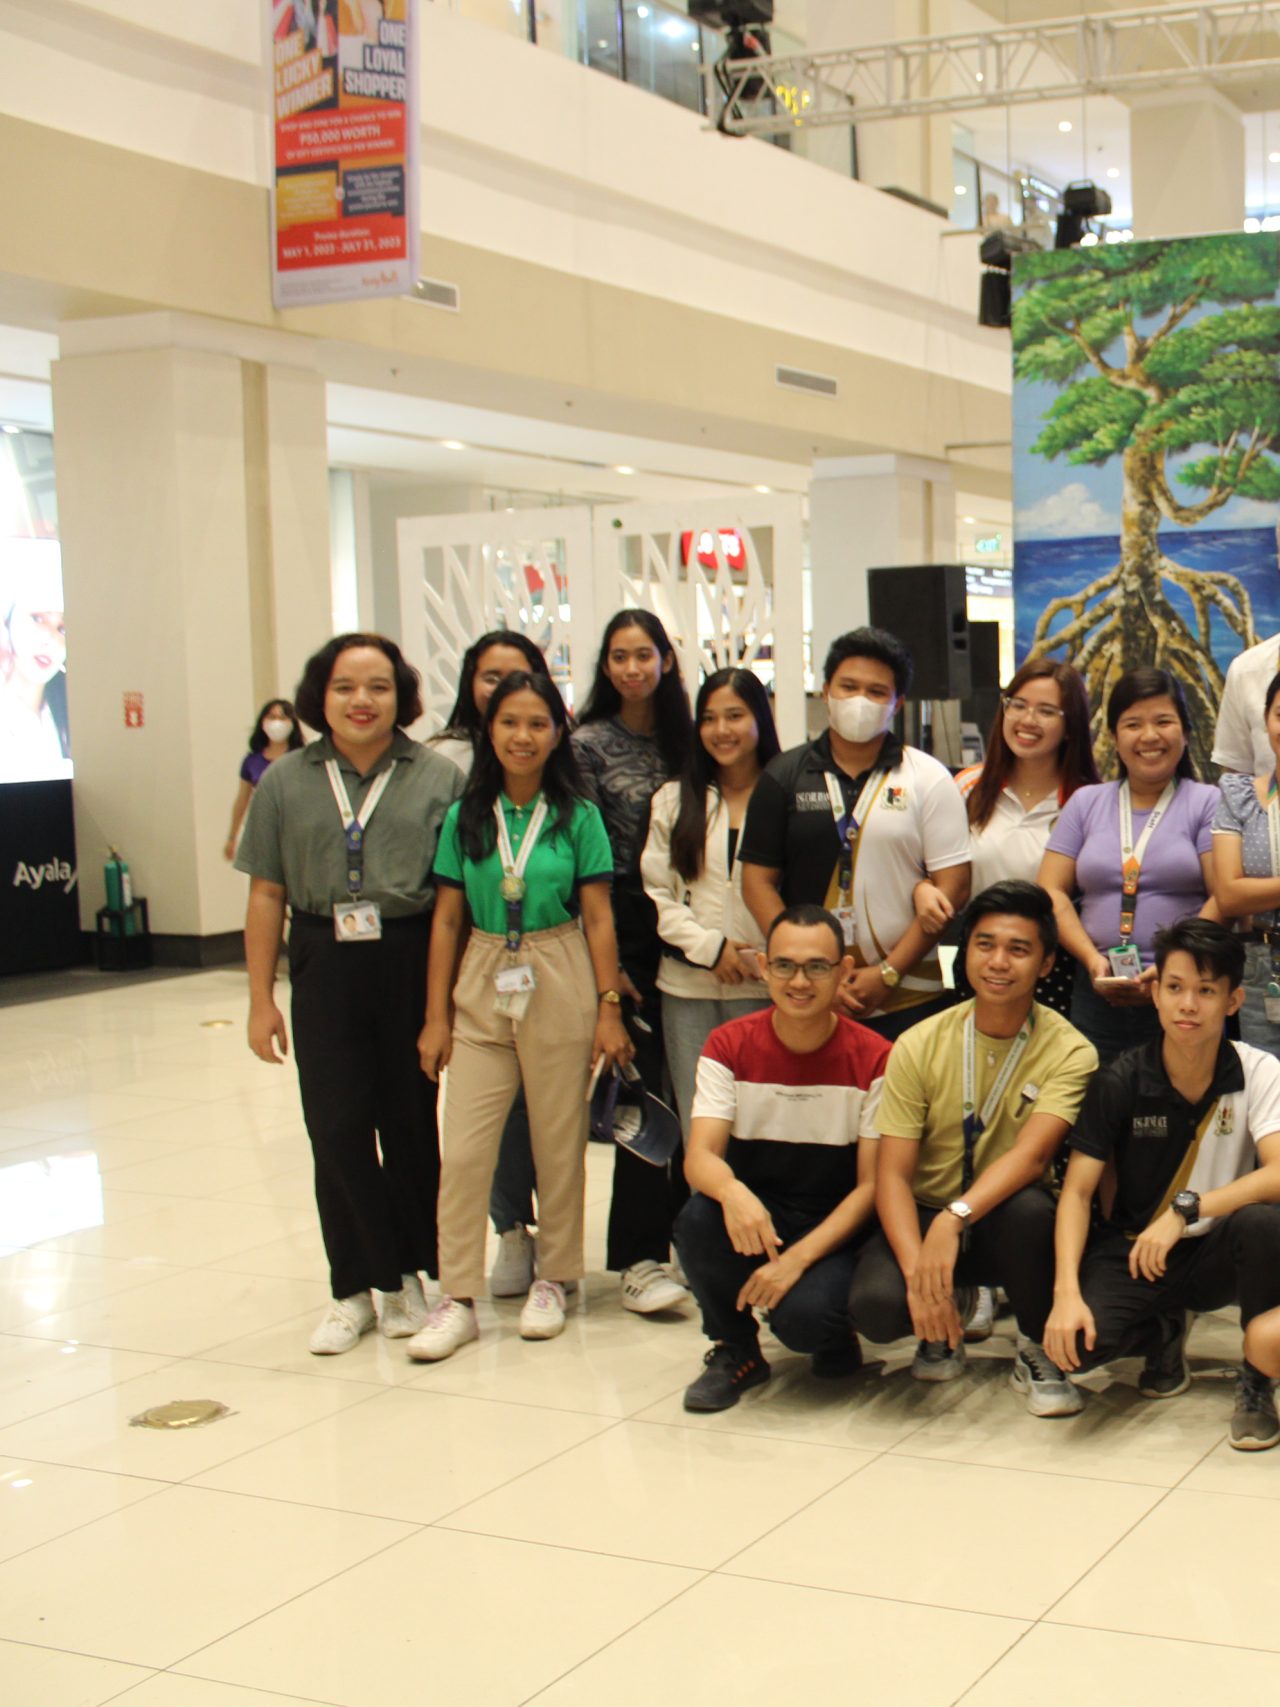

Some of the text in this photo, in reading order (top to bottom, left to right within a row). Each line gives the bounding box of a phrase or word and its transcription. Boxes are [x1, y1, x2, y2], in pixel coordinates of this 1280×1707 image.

[380, 22, 407, 46] ONE
[366, 48, 406, 72] LOYAL
[346, 70, 406, 99] SHOPPER
[341, 124, 380, 140] WORTH
[282, 246, 302, 258] MAY
[313, 243, 335, 256] 2023
[342, 241, 361, 254] JULY
[378, 236, 401, 249] 2023
[12, 855, 71, 890] Ayala
